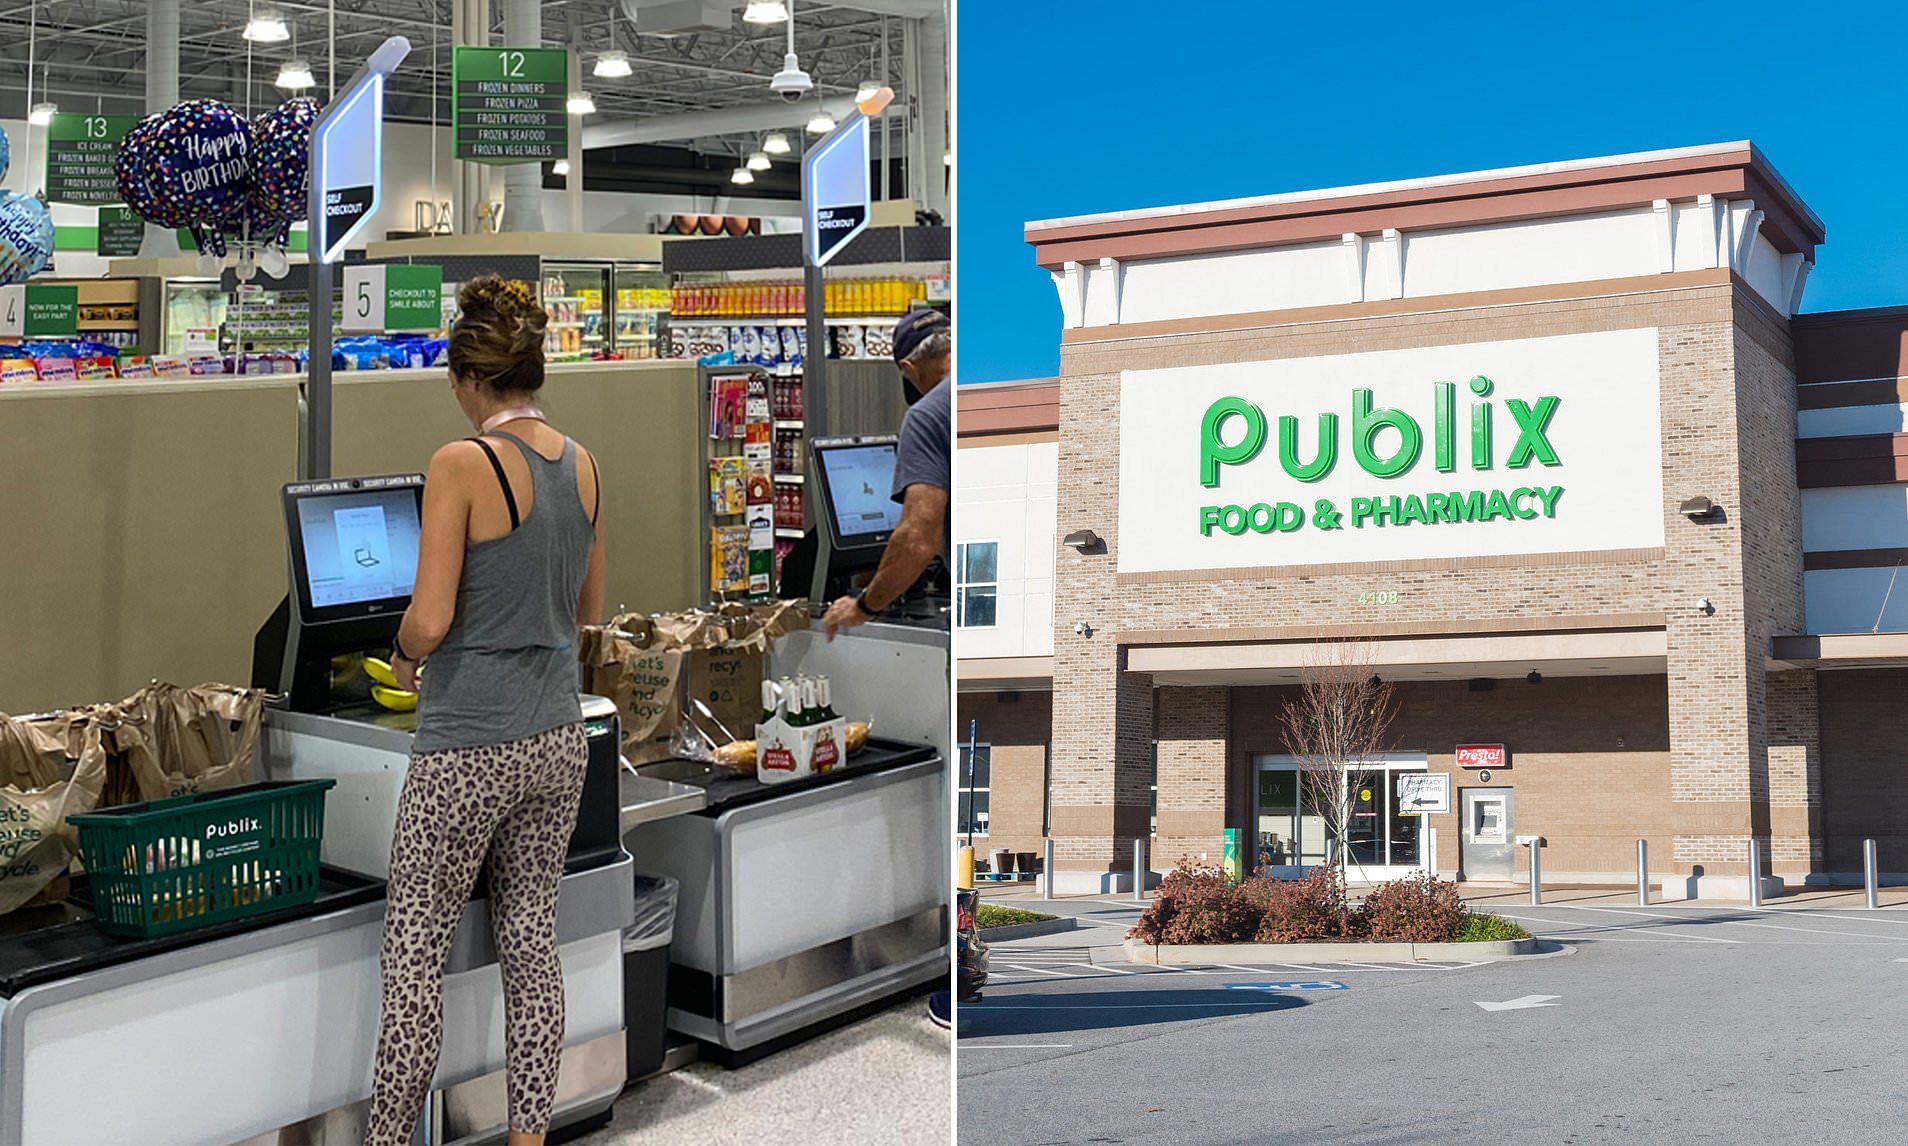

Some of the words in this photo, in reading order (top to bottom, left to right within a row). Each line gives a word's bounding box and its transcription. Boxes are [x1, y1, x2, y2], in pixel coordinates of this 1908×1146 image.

[498, 51, 526, 77] 12
[478, 82, 508, 93] FROZEN
[510, 82, 545, 94] DINNERS
[485, 97, 515, 109] FROZEN
[517, 98, 538, 109] PIZZA
[477, 113, 507, 125] FROZEN
[509, 113, 546, 125] POTATOES
[84, 117, 107, 138] 13
[479, 129, 508, 140] FROZEN
[511, 129, 546, 141] SEAFOOD
[77, 142, 88, 150] ICE
[89, 142, 112, 150] CREAM
[182, 131, 247, 161] Happy
[473, 144, 503, 156] FROZEN
[505, 145, 552, 156] VEGETABLES
[58, 154, 83, 162] FROZEN
[60, 166, 85, 174] FROZEN
[181, 157, 250, 193] BIRTHDA
[63, 179, 88, 187] FROZEN
[62, 191, 87, 199] FROZEN
[327, 192, 342, 204] SELF
[119, 208, 132, 220] 16
[327, 203, 363, 216] CHECKOUT
[818, 218, 855, 229] CHECKOUT
[389, 289, 426, 298] CHECKOUT
[428, 289, 437, 297] TO
[357, 282, 371, 318] 5
[389, 300, 411, 309] SMILE
[412, 299, 436, 309] ABOUT
[6, 297, 16, 326] 4
[33, 312, 50, 320] EASY
[51, 312, 69, 320] PART
[1199, 375, 1562, 488] Publix
[1200, 501, 1304, 537] FOOD
[1311, 498, 1343, 530] &
[1350, 485, 1564, 528] PHARMACY
[1359, 590, 1399, 605] 4108
[632, 673, 670, 687] euse
[1458, 750, 1500, 761] Presta!
